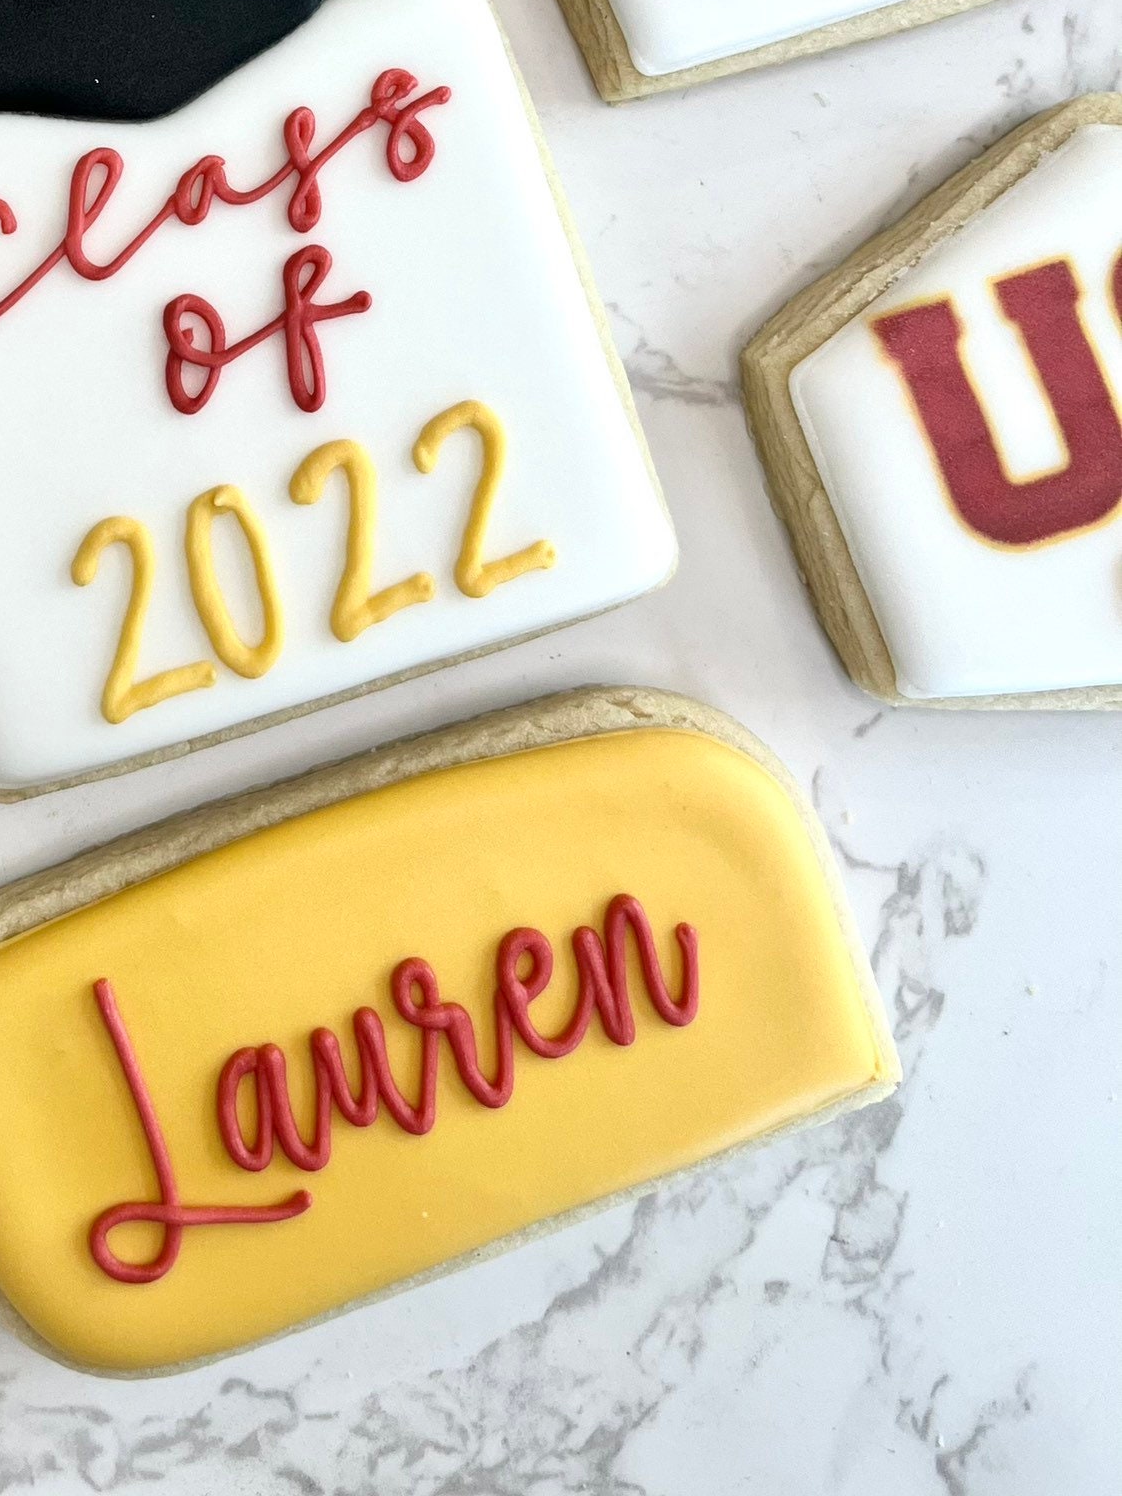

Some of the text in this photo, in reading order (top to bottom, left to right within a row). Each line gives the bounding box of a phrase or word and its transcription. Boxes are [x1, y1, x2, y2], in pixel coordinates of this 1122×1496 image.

[162, 243, 373, 415] of
[70, 399, 558, 724] 2022
[89, 893, 700, 1284] Lauren
